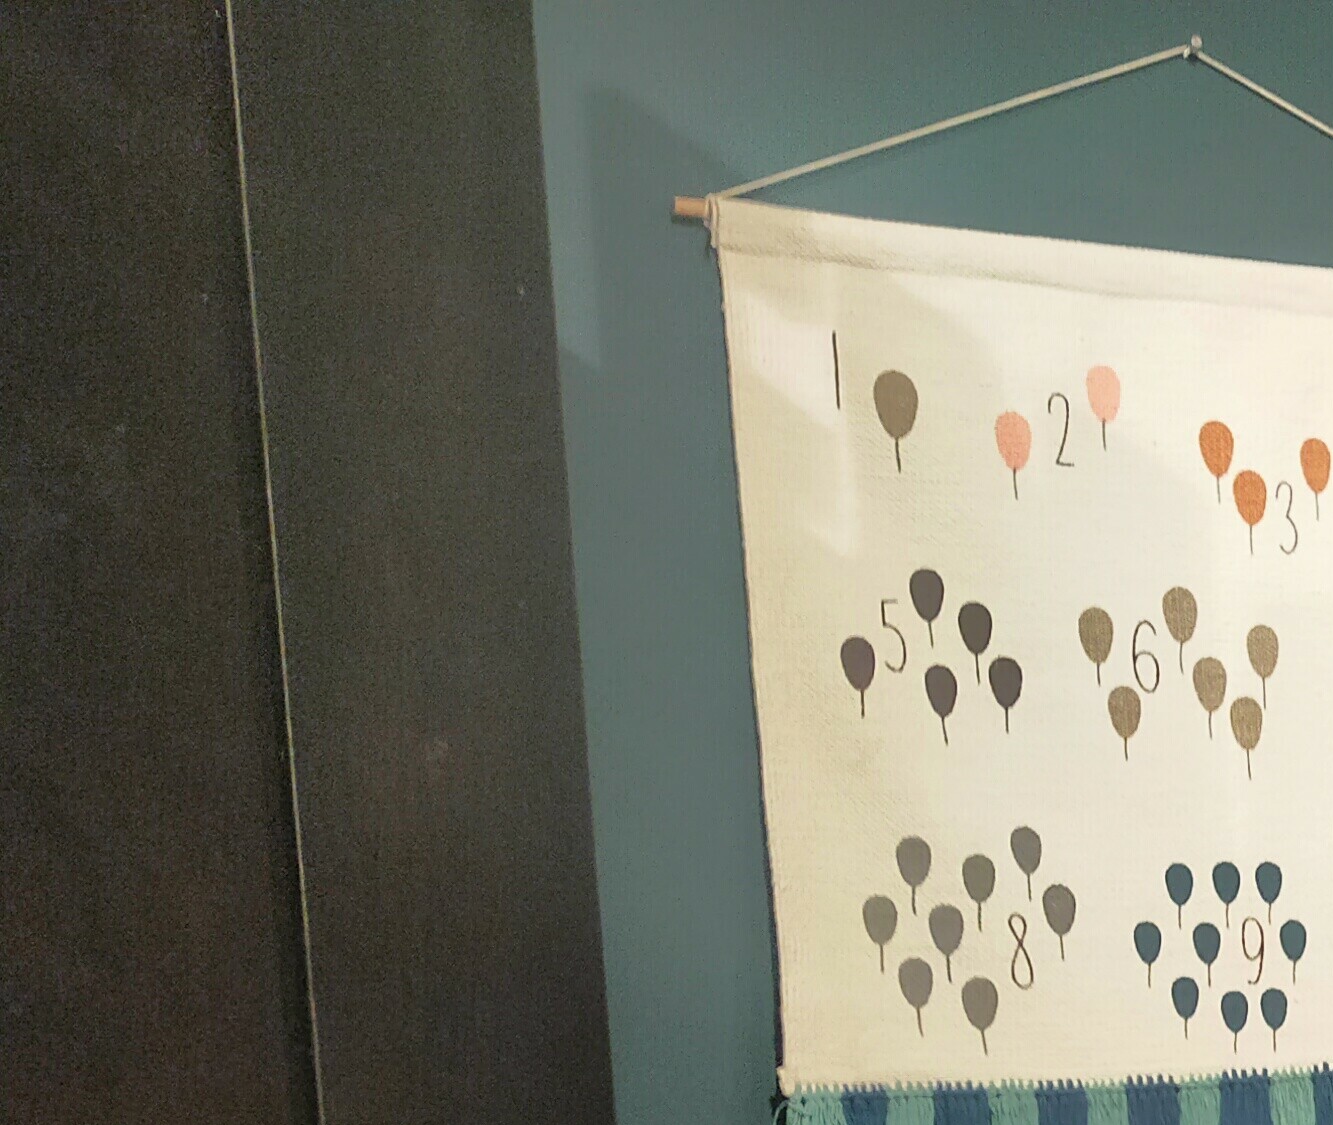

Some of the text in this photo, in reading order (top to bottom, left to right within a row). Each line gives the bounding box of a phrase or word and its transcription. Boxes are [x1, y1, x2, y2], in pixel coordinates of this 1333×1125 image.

[1048, 392, 1076, 468] 2
[1274, 481, 1299, 555] 3
[880, 598, 908, 673] 5
[1132, 619, 1161, 694] 6
[1008, 912, 1034, 990] 8
[1240, 915, 1265, 986] 9
